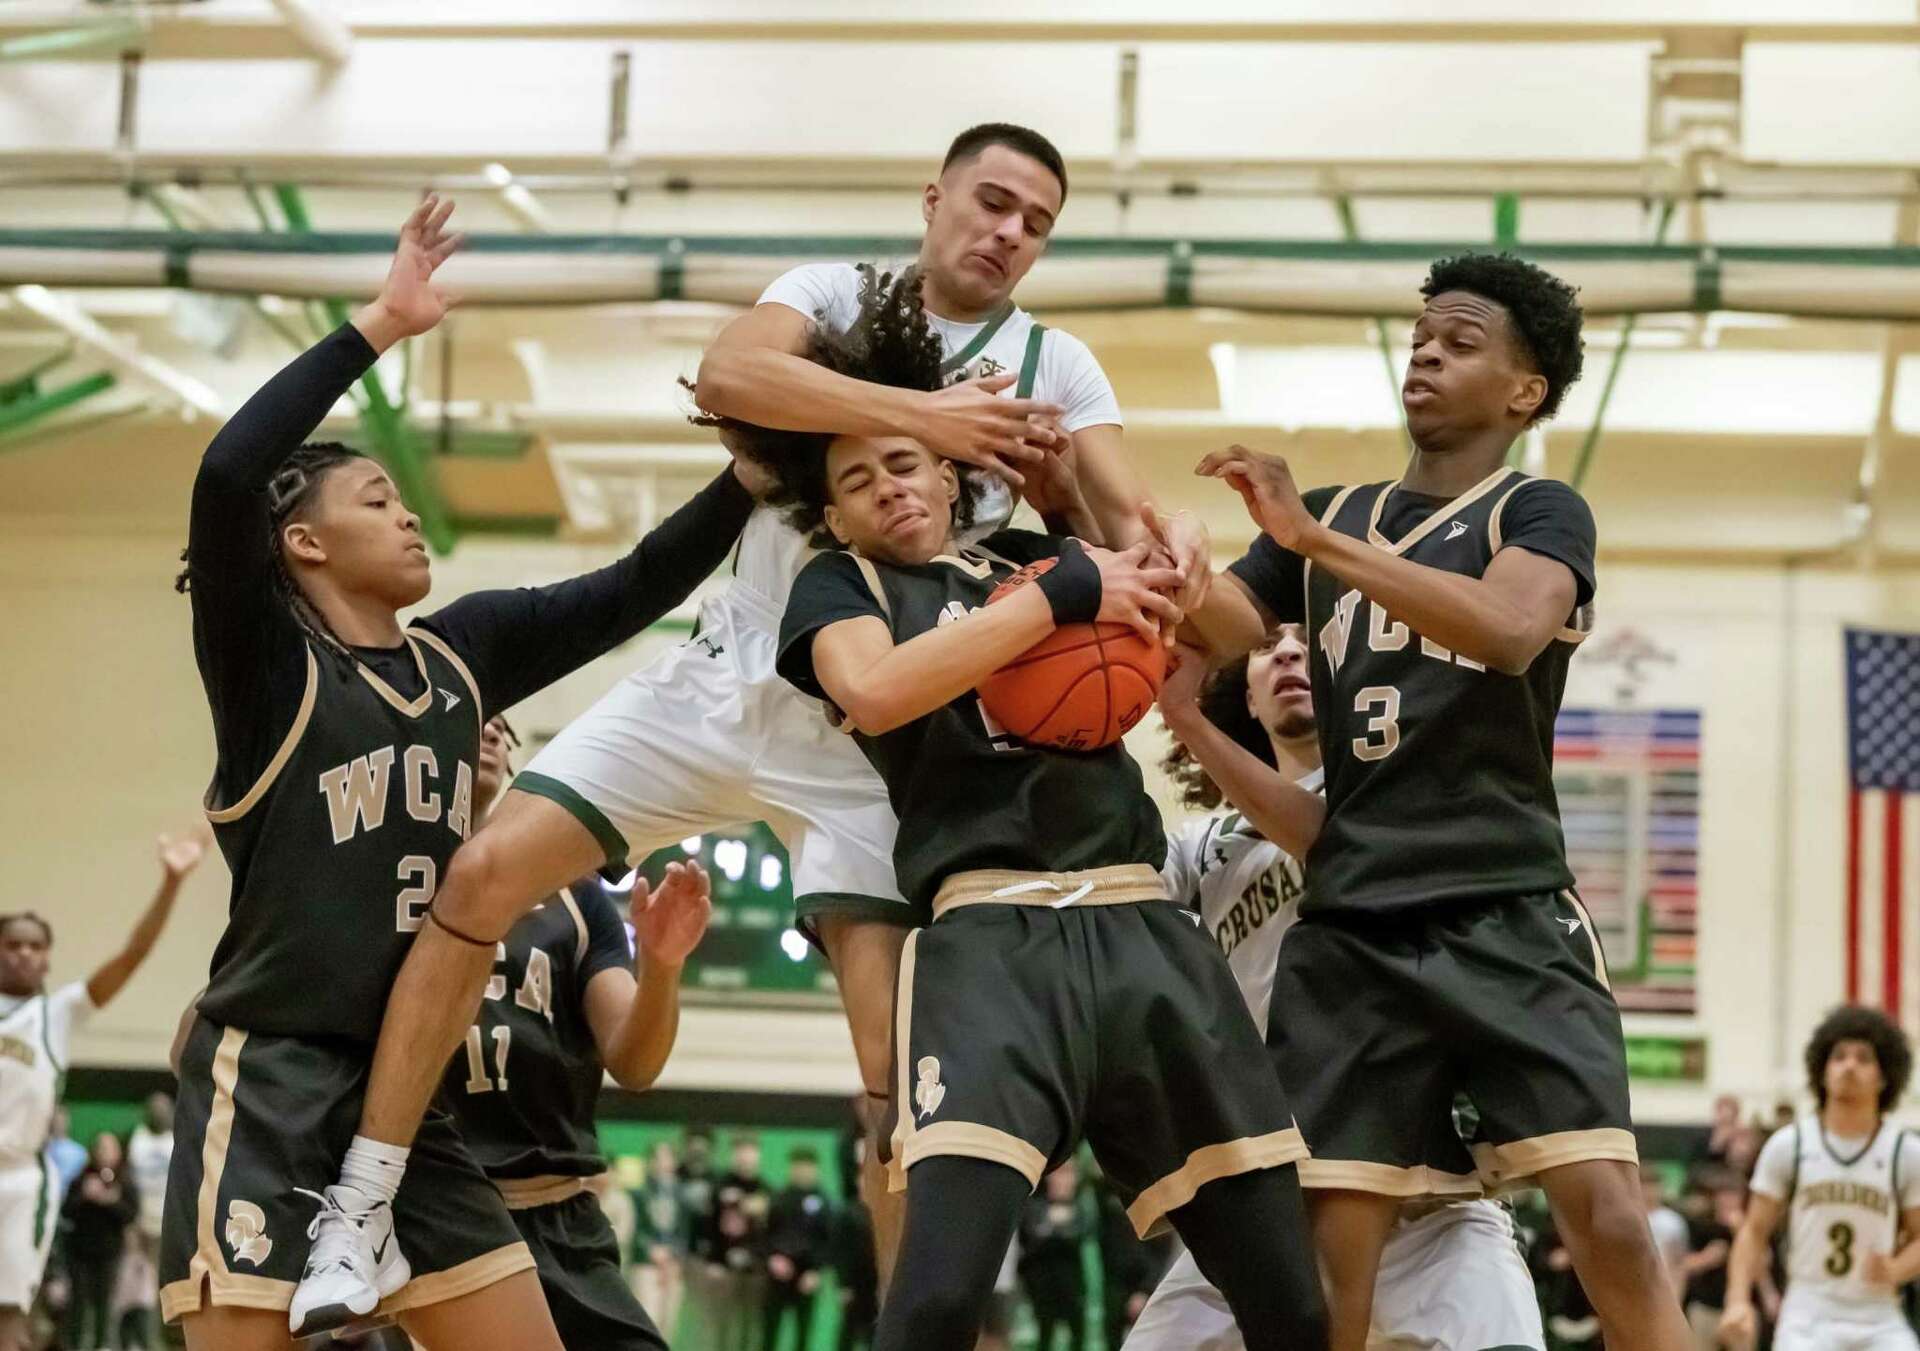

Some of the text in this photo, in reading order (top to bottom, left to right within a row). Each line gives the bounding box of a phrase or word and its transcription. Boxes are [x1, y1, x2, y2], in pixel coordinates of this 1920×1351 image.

[1319, 588, 1486, 684] WC
[1352, 686, 1401, 762] 3
[319, 744, 472, 846] WCA
[396, 855, 437, 932] 2
[466, 1024, 511, 1094] 11
[1825, 1222, 1854, 1277] 3
